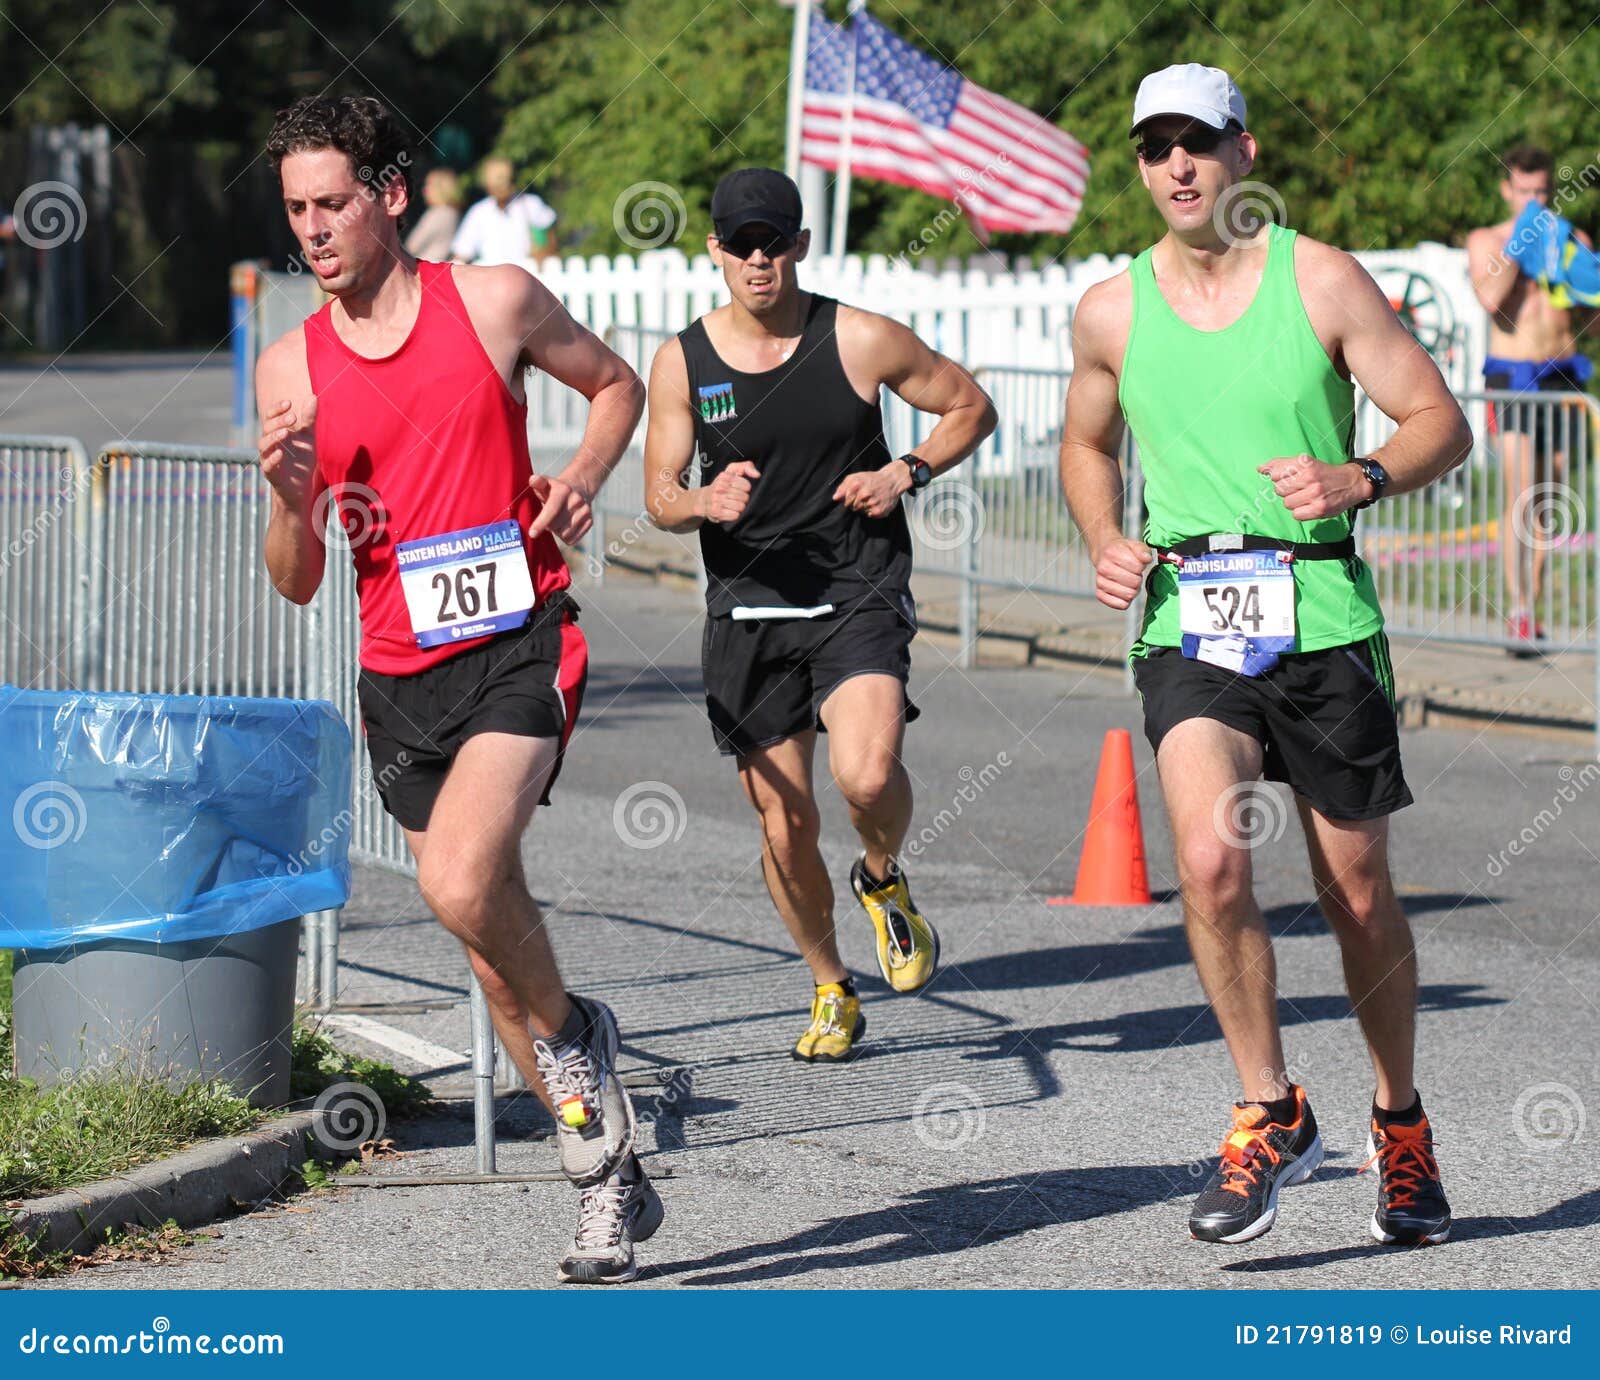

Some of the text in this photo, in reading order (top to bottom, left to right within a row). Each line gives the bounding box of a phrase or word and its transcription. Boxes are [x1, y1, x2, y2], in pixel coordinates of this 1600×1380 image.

[397, 528, 520, 565] STATEN ISLAND HALF
[485, 540, 521, 553] MARATHON
[1209, 558, 1254, 573] ISLAND
[1255, 557, 1289, 570] HAL
[431, 561, 498, 623] 267
[1202, 585, 1265, 633] 524
